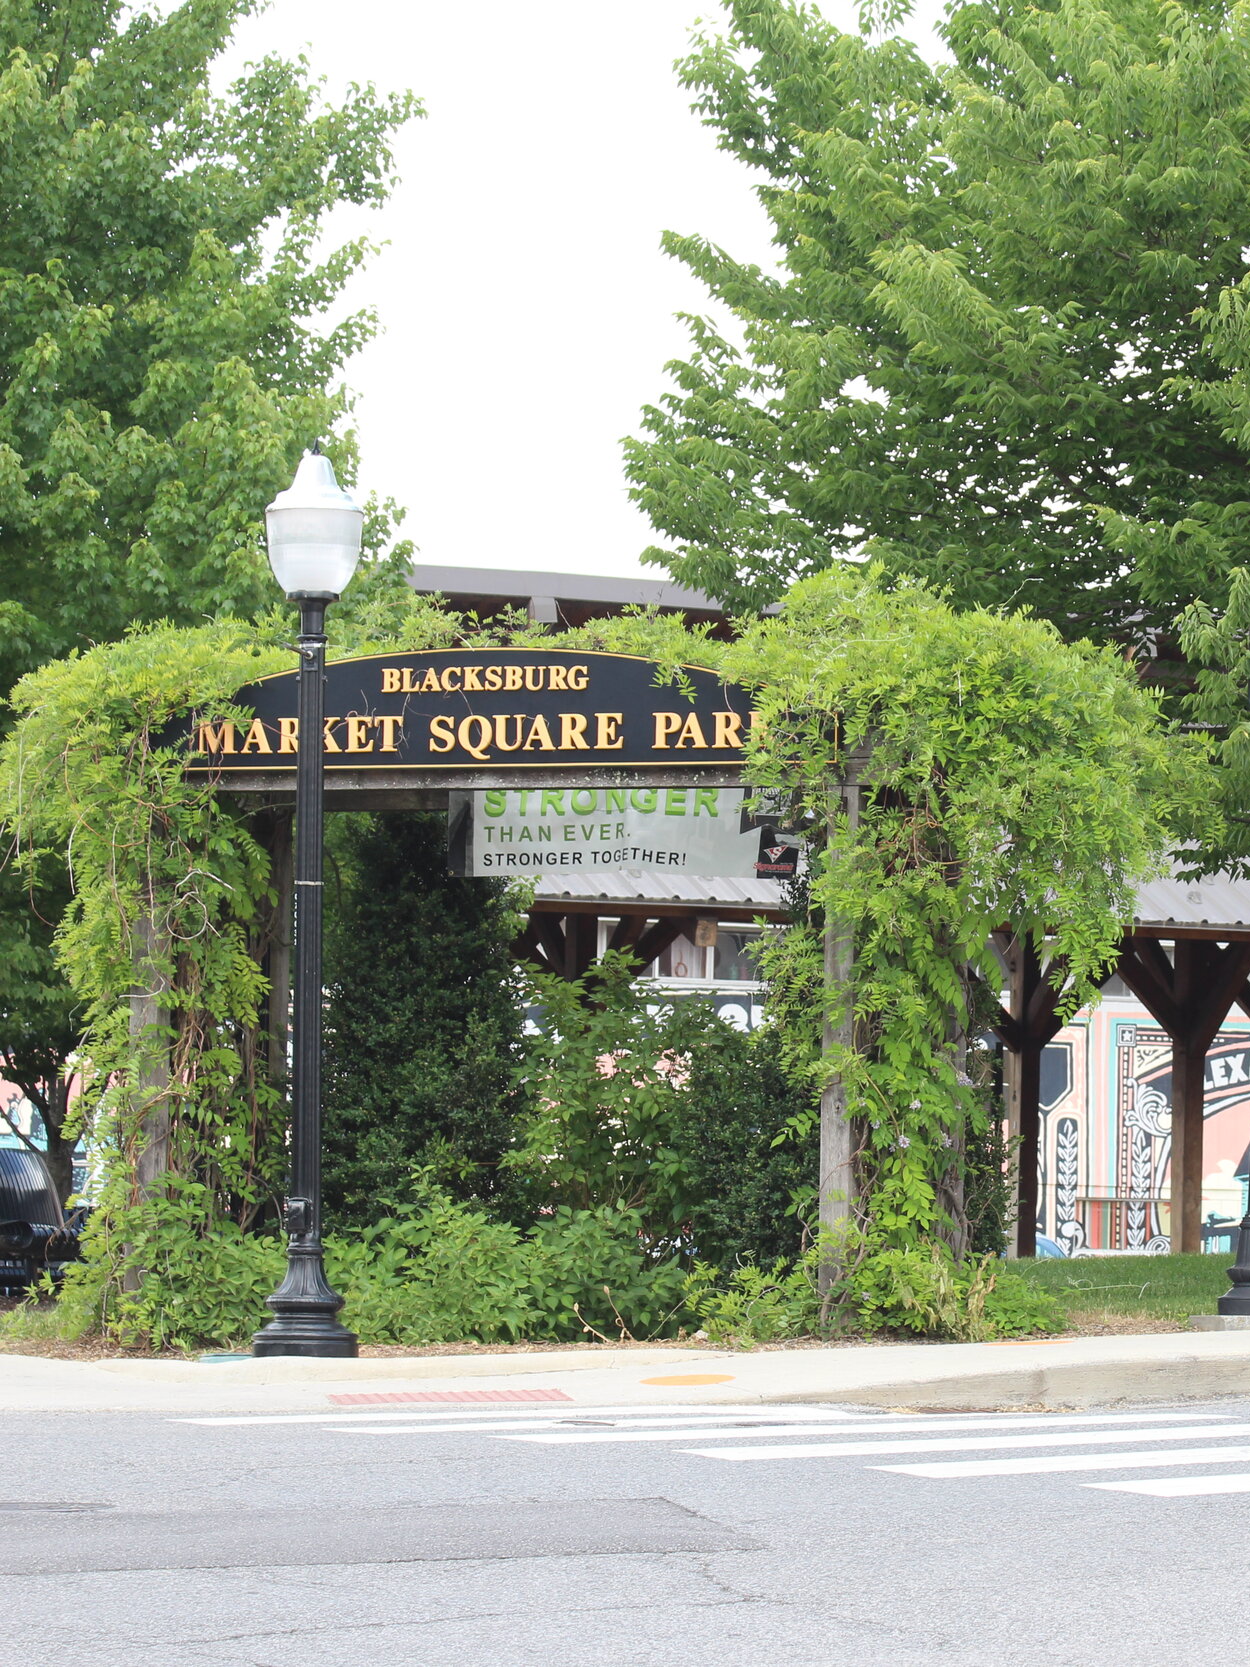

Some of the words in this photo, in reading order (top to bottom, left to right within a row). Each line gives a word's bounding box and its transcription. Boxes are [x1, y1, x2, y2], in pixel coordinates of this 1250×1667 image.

[381, 665, 590, 693] BLACKSBURG
[429, 712, 624, 760] SQUARE
[484, 789, 720, 818] STRONGER
[484, 825, 552, 843] THAN
[563, 822, 631, 842] EVER.
[483, 851, 583, 867] STRONGER
[590, 847, 687, 866] TOGETHER!
